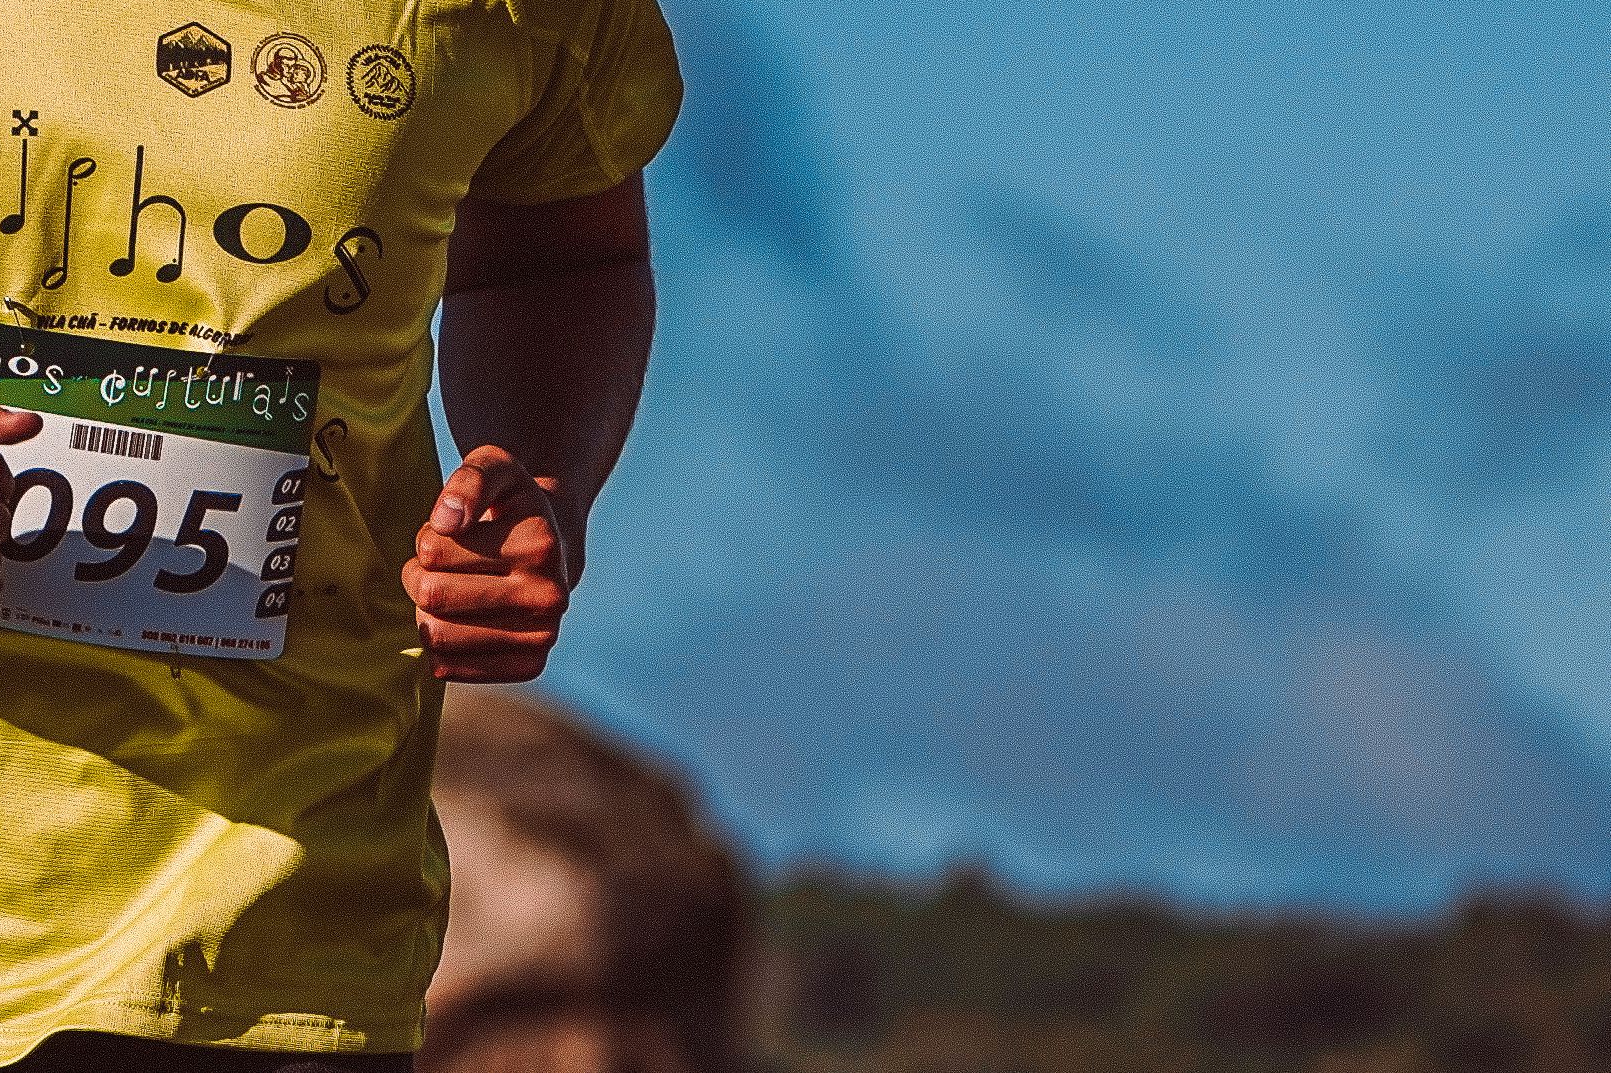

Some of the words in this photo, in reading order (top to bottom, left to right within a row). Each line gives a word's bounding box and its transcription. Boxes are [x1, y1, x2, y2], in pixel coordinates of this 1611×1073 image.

[109, 316, 168, 335] FORNOS
[168, 320, 189, 335] DE
[281, 479, 301, 495] 01
[275, 516, 296, 532] 02
[270, 555, 291, 571] 03
[264, 592, 286, 609] 04
